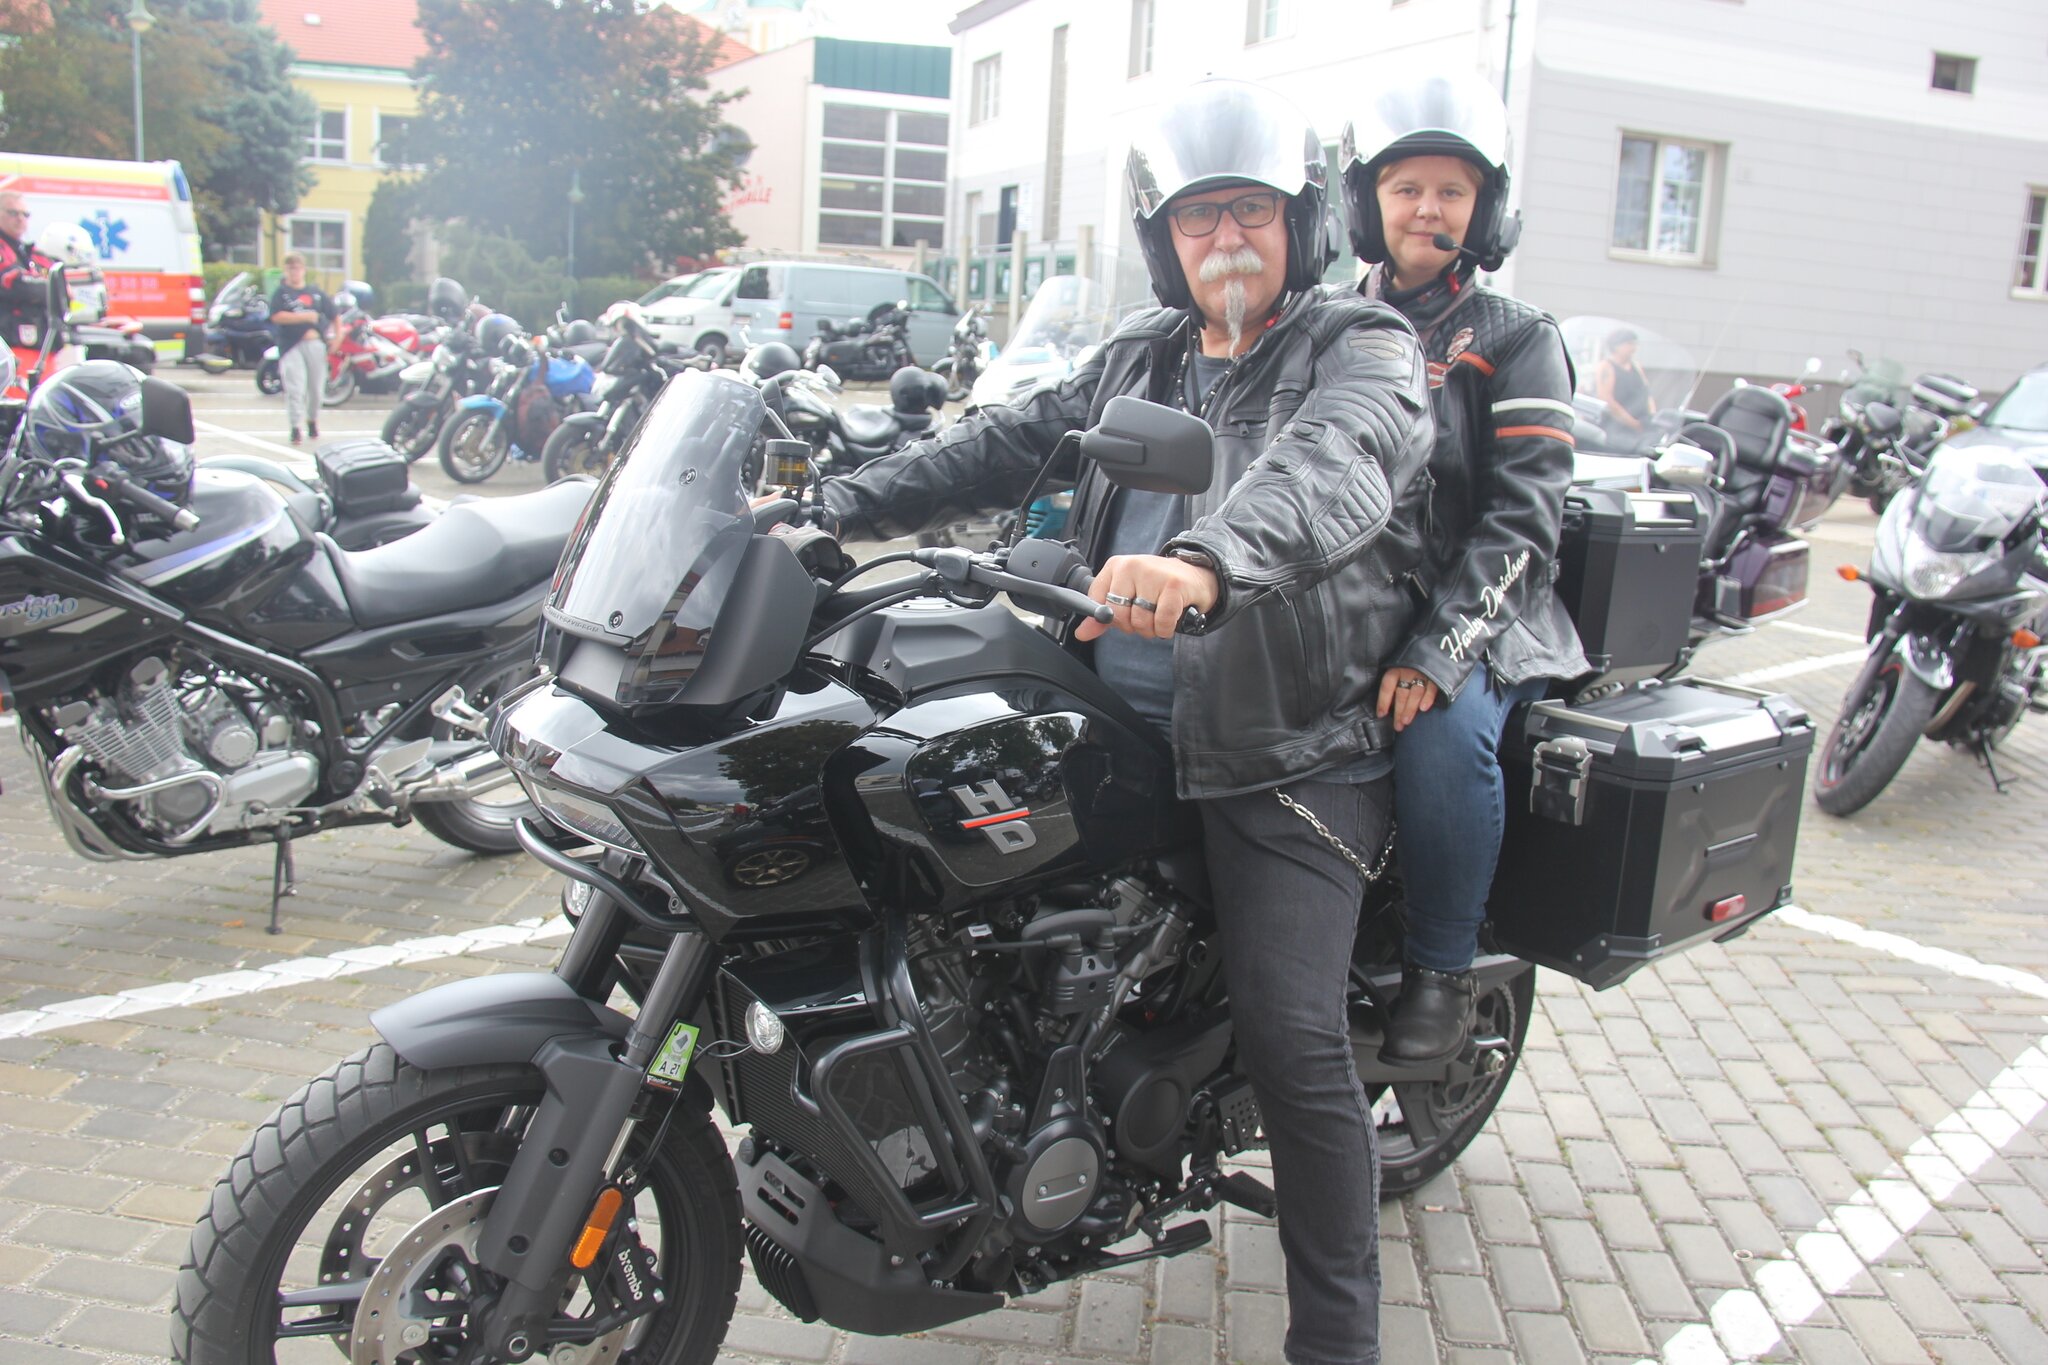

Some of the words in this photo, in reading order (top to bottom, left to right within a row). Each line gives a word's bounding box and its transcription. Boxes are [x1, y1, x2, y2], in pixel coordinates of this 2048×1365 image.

[24, 597, 78, 625] 900
[659, 1061, 668, 1072] A
[670, 1063, 681, 1075] 21
[618, 1248, 643, 1301] brembo
